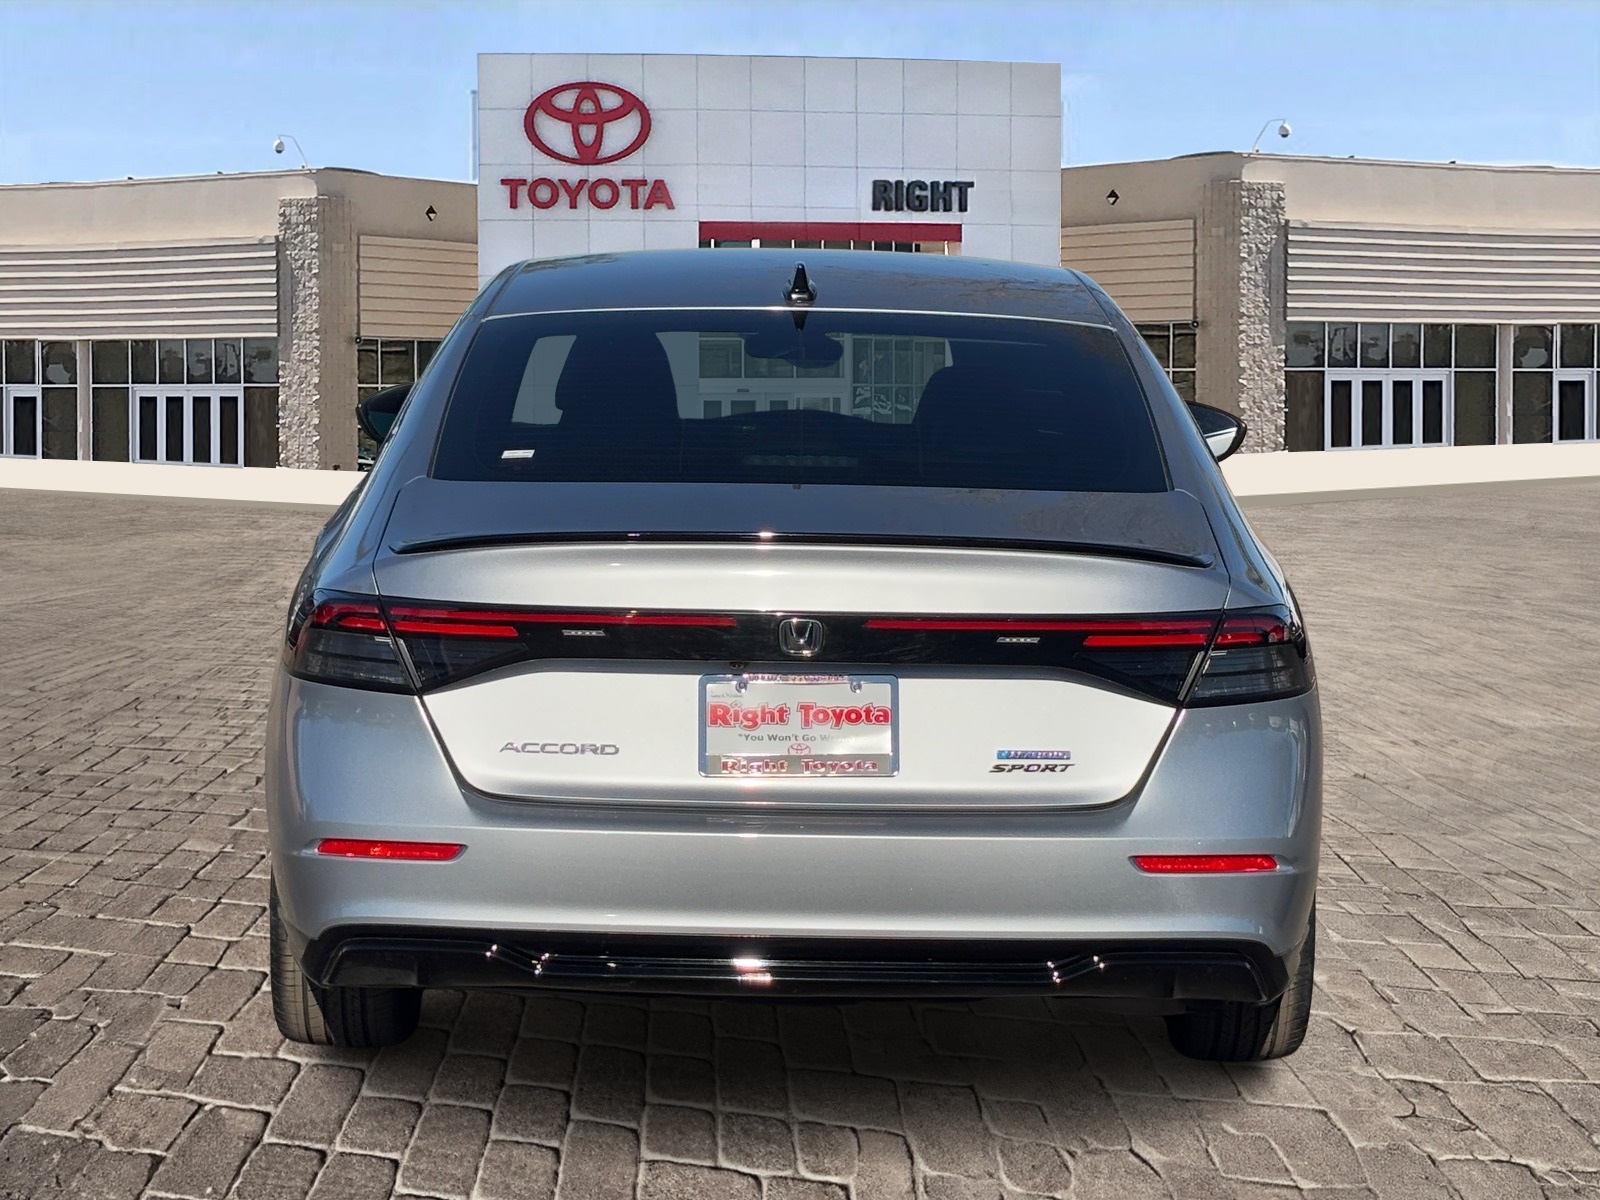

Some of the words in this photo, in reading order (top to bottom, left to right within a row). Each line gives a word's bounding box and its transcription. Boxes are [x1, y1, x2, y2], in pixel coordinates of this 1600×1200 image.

[500, 178, 675, 210] TOYOTA
[871, 179, 975, 212] RIGHT
[708, 702, 790, 731] Right
[797, 702, 892, 729] Toyota
[767, 733, 799, 742] Won't
[802, 733, 816, 742] Go
[499, 742, 619, 755] ACCORD
[721, 756, 788, 774] Right
[801, 758, 879, 774] Toyota
[989, 763, 1075, 773] SPORT
